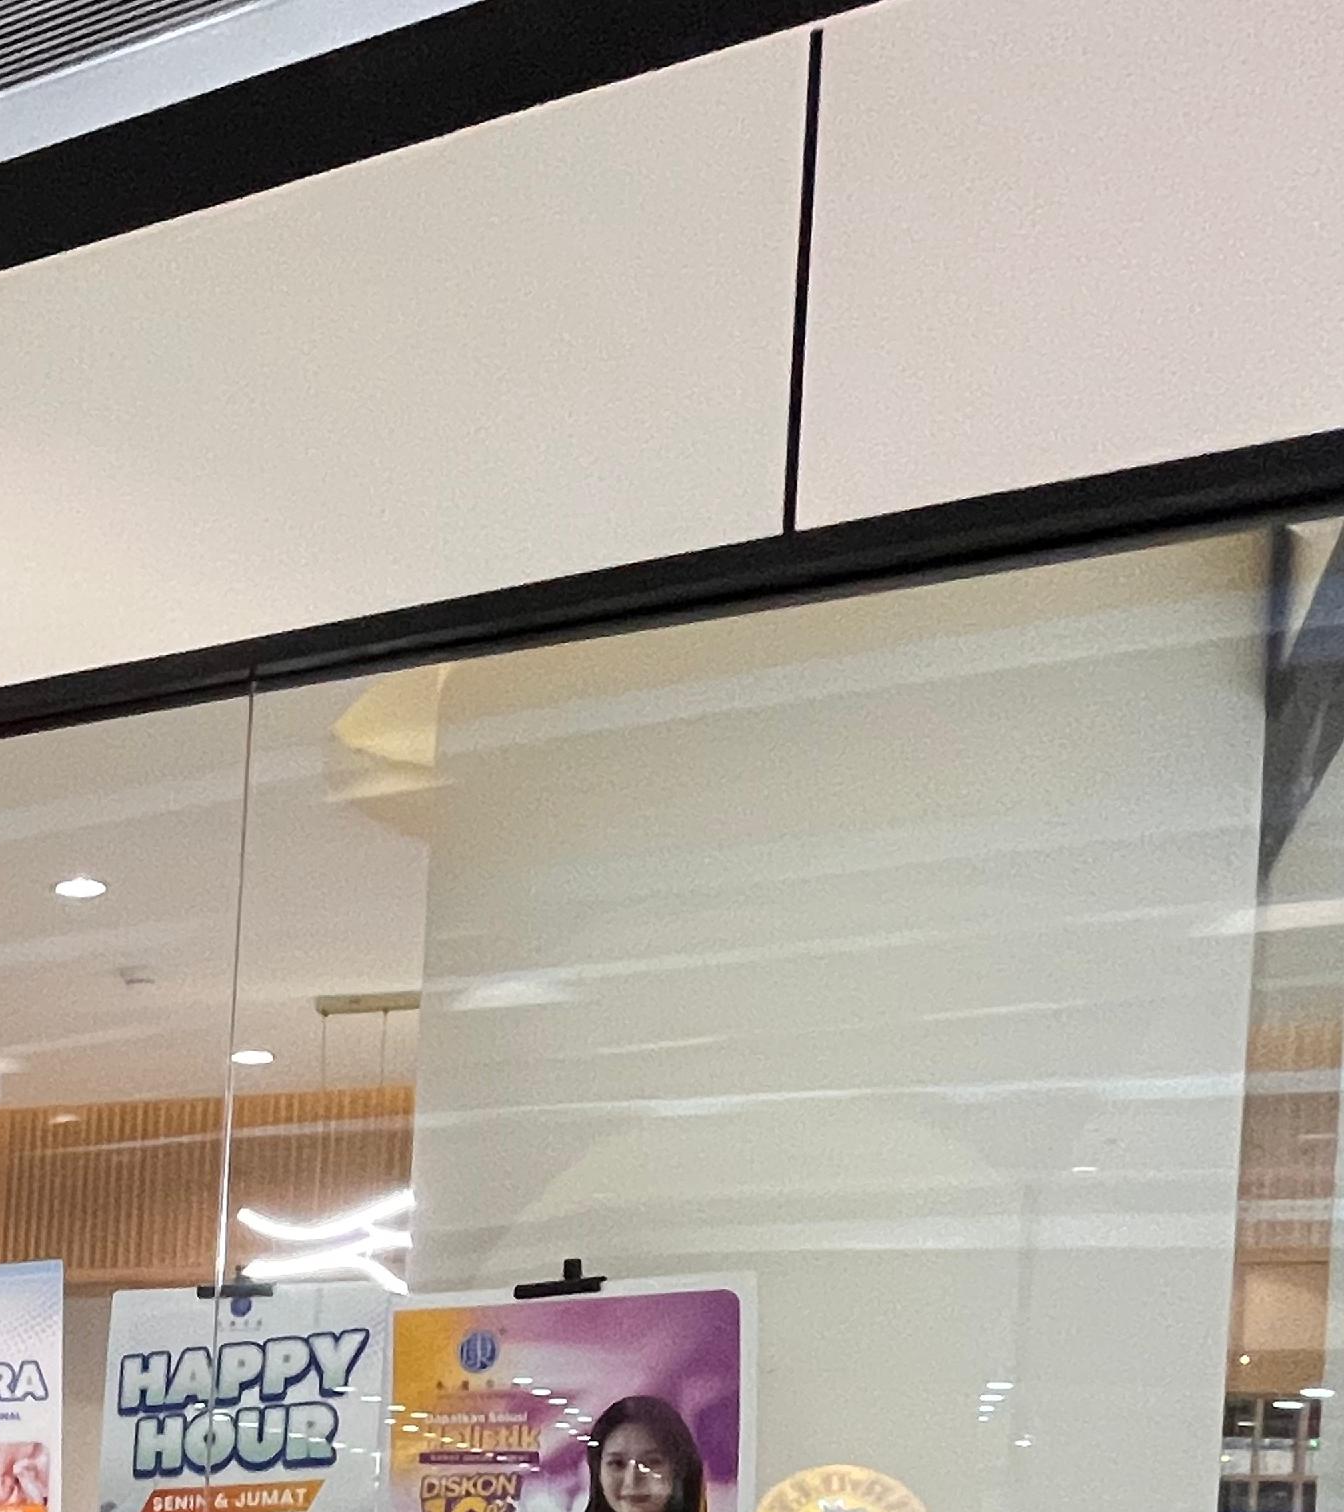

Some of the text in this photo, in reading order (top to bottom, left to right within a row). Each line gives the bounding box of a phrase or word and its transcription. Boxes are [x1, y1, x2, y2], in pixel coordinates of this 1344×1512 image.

[118, 1328, 370, 1416] HAPPY
[133, 1401, 339, 1479] HOUR
[153, 1488, 308, 1512] SENIN & JUMAT
[421, 1474, 521, 1498] DISKON
